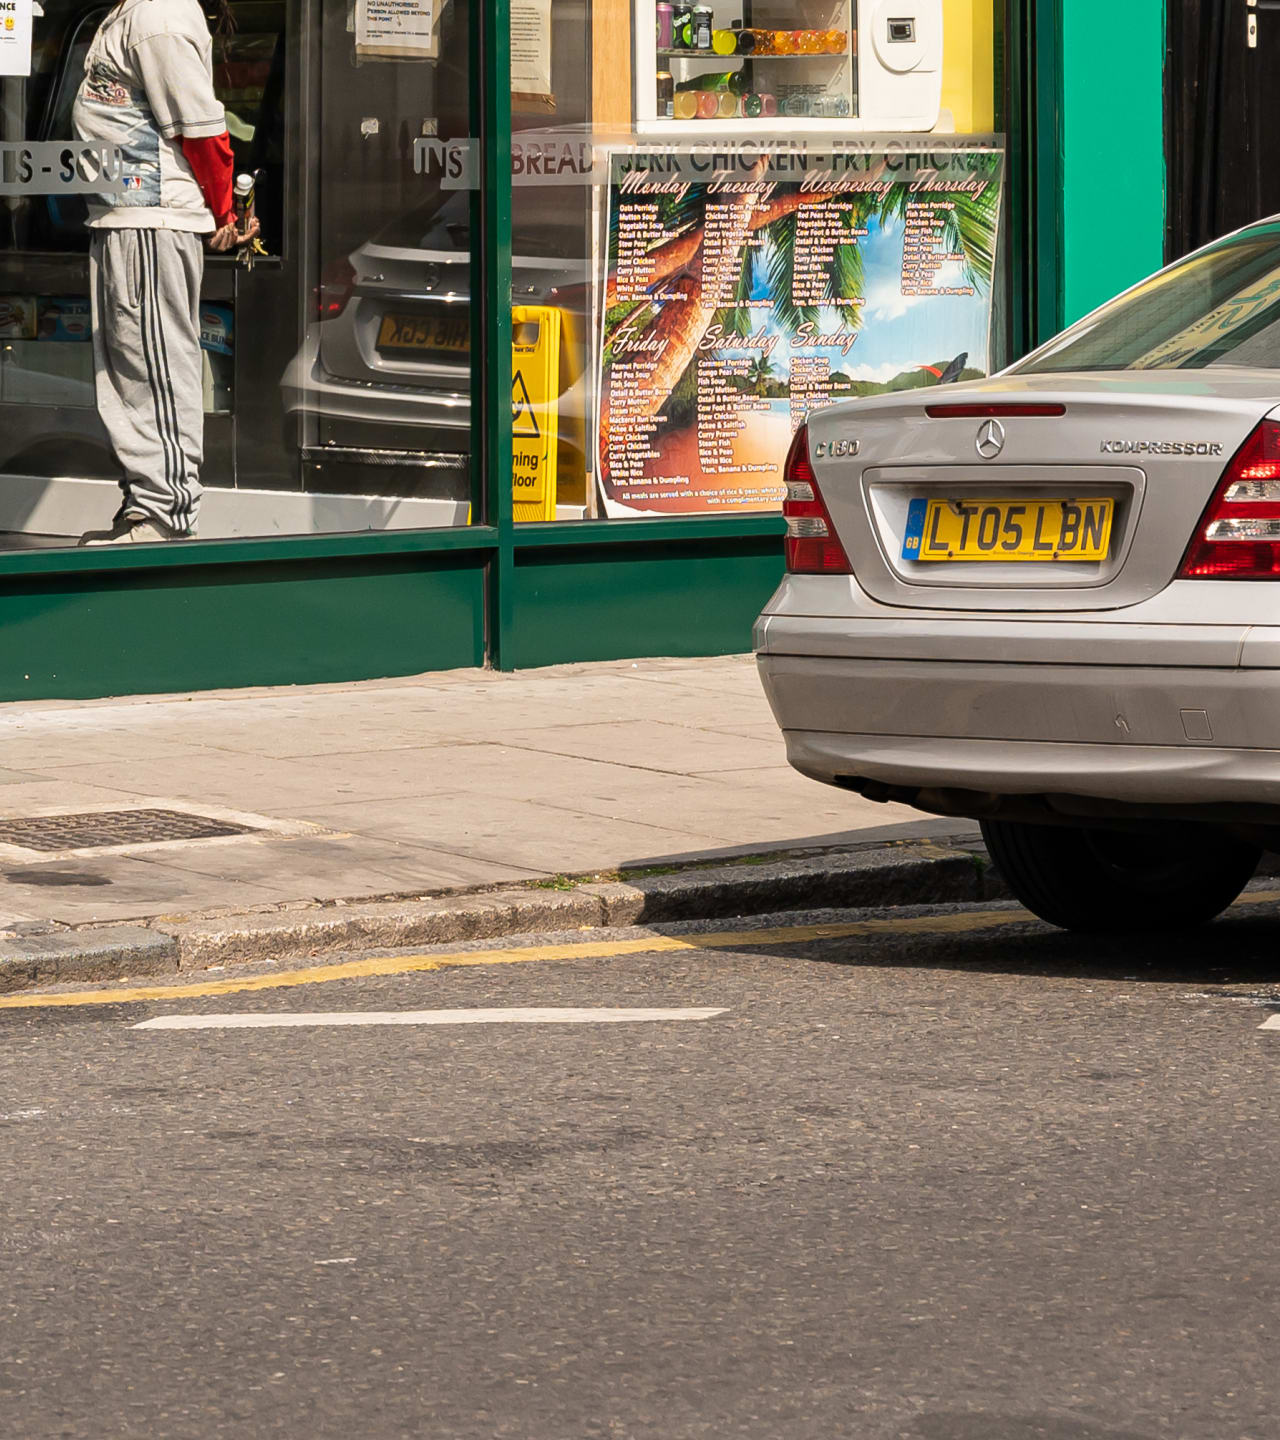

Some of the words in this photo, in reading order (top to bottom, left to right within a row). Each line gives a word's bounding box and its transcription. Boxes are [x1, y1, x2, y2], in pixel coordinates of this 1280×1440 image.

[512, 143, 592, 175] BREAD
[621, 141, 679, 173] JERK
[689, 139, 808, 173] CHICKEN
[832, 140, 875, 173] FRY
[887, 139, 999, 173] CHICKEN
[620, 169, 691, 203] Monday
[707, 169, 778, 202] Tuesday
[800, 169, 894, 202] Wednesday
[909, 168, 989, 201] Thursday
[634, 204, 658, 213] Porridge
[642, 213, 657, 221] Soup
[919, 211, 934, 219] Soup
[930, 202, 955, 210] Porridge
[619, 222, 648, 230] Vegetable
[649, 222, 664, 230] Soup
[831, 228, 850, 236] Butter
[851, 228, 869, 236] Beans
[617, 267, 633, 275] Curry
[612, 327, 669, 361] Friday
[698, 324, 779, 358] Saturday
[791, 321, 858, 356] Sunday
[1100, 439, 1223, 457] KOMPRESSOR
[928, 505, 1023, 551] LT05
[1033, 504, 1108, 552] LBN
[905, 536, 922, 550] GB
